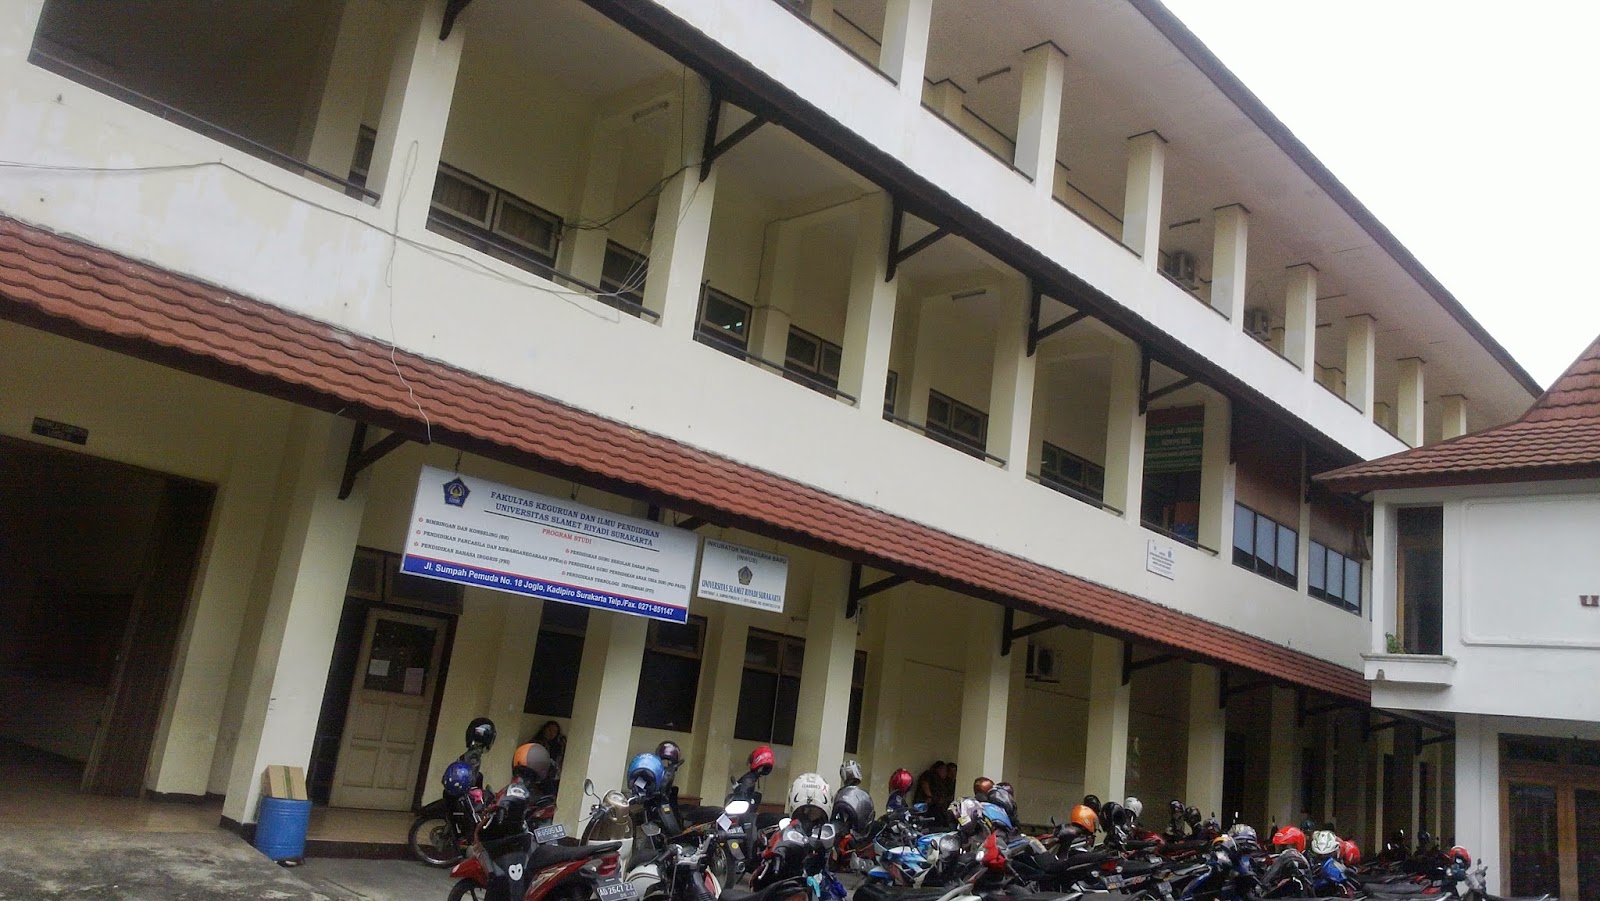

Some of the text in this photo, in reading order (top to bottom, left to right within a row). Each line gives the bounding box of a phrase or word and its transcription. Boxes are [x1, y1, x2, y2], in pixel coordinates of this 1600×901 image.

[490, 491, 660, 538] FAKULTAS KEGURUAN DAN ILMU PENDIDIKAN
[496, 503, 652, 546] UNIVERSITAS SLAMET RIYADI SURAKARTA
[423, 530, 456, 542] PENDIDIKAN
[458, 538, 486, 548] PANCASILA
[426, 518, 456, 530] BIMBINGAN
[469, 528, 498, 539] KONSELING
[542, 528, 592, 544] PROGRAM STUDI
[420, 542, 454, 554] PENDIDIKAN
[455, 550, 476, 558] BAHASA
[708, 540, 786, 564] INKUBATOR WIRAUSAHA BARU
[436, 564, 467, 577] Sumpah
[468, 570, 499, 582] Pemuda
[500, 576, 512, 585] No.
[514, 579, 522, 587] 18
[524, 581, 546, 592] Joglo,
[546, 584, 576, 597] Kadipiro
[576, 590, 607, 604] Surakarta
[638, 602, 674, 616] 0271-851147
[702, 580, 728, 592] UNIVERSITAS
[728, 584, 744, 595] SLAMET
[744, 588, 759, 598] RIYADI
[758, 591, 782, 602] SURAKARTA
